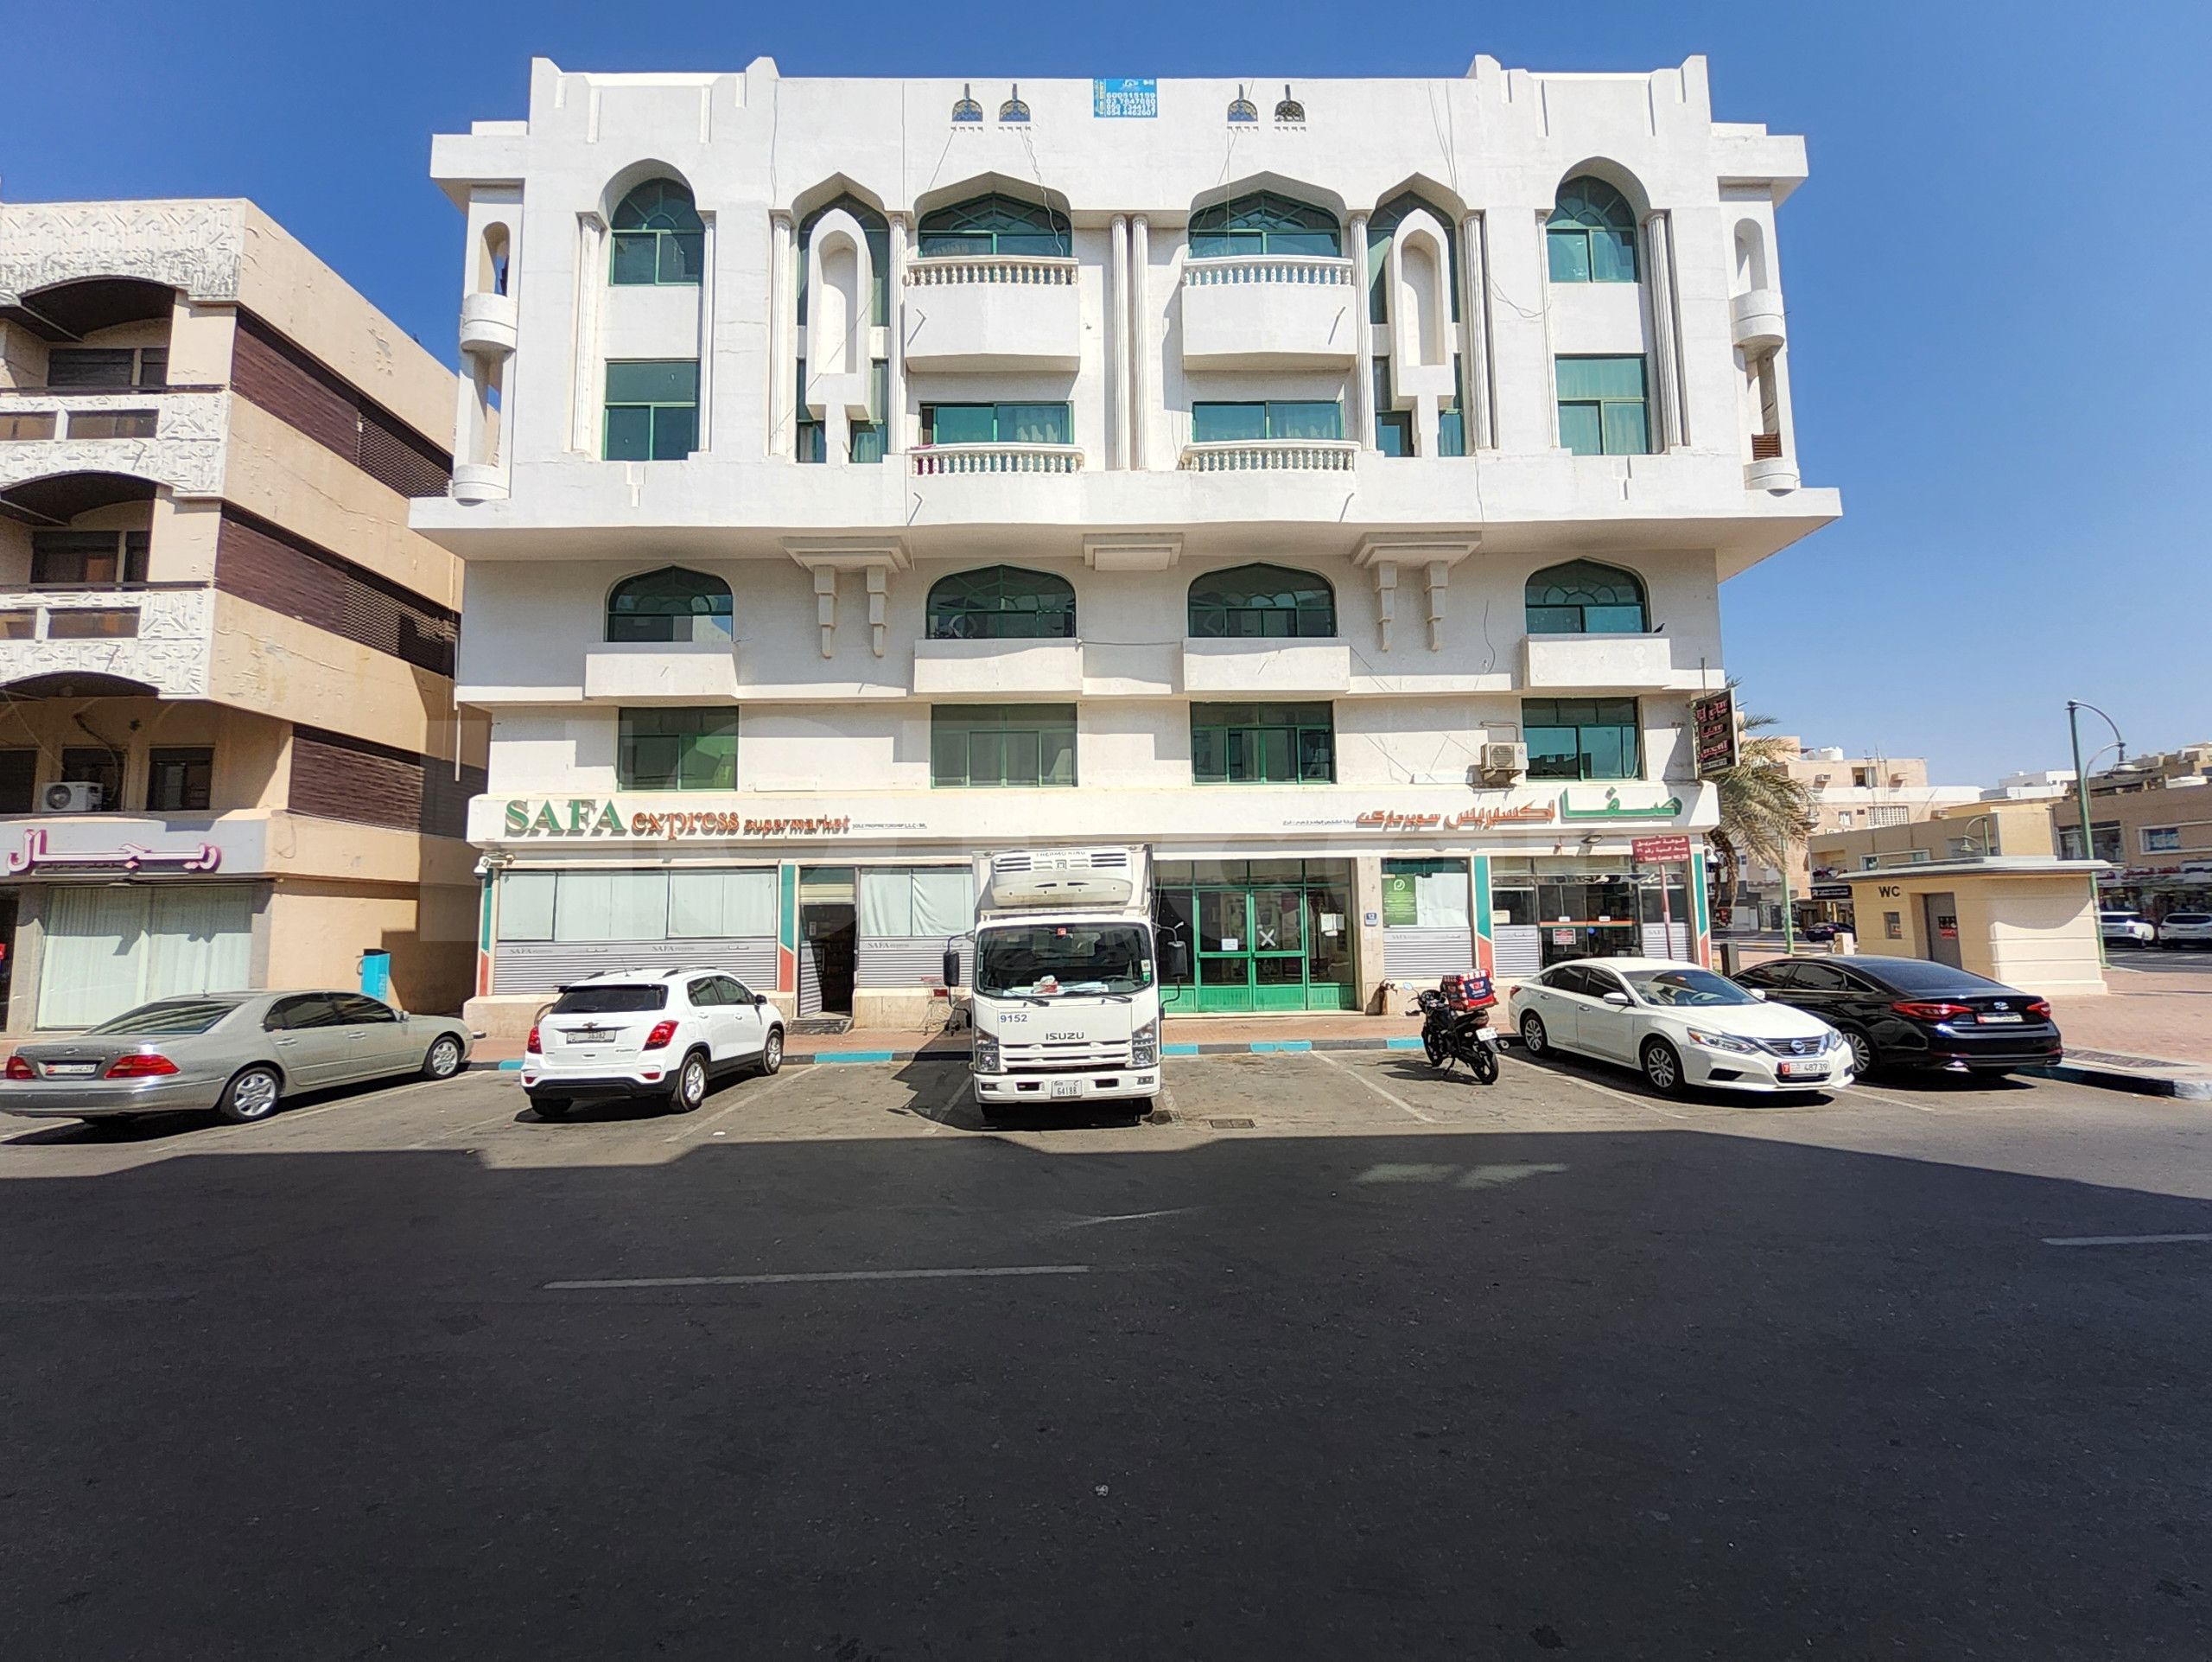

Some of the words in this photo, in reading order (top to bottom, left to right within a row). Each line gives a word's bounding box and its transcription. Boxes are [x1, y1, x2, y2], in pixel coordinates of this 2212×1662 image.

[1559, 786, 1683, 819] صفا
[505, 798, 627, 835] SAFA
[631, 809, 740, 841] express
[743, 814, 851, 835] supermarket
[1878, 885, 1902, 898] WC
[1000, 1014, 1028, 1023] 9152
[1045, 1031, 1084, 1041] ISUZU
[1803, 1063, 1828, 1072] 48739
